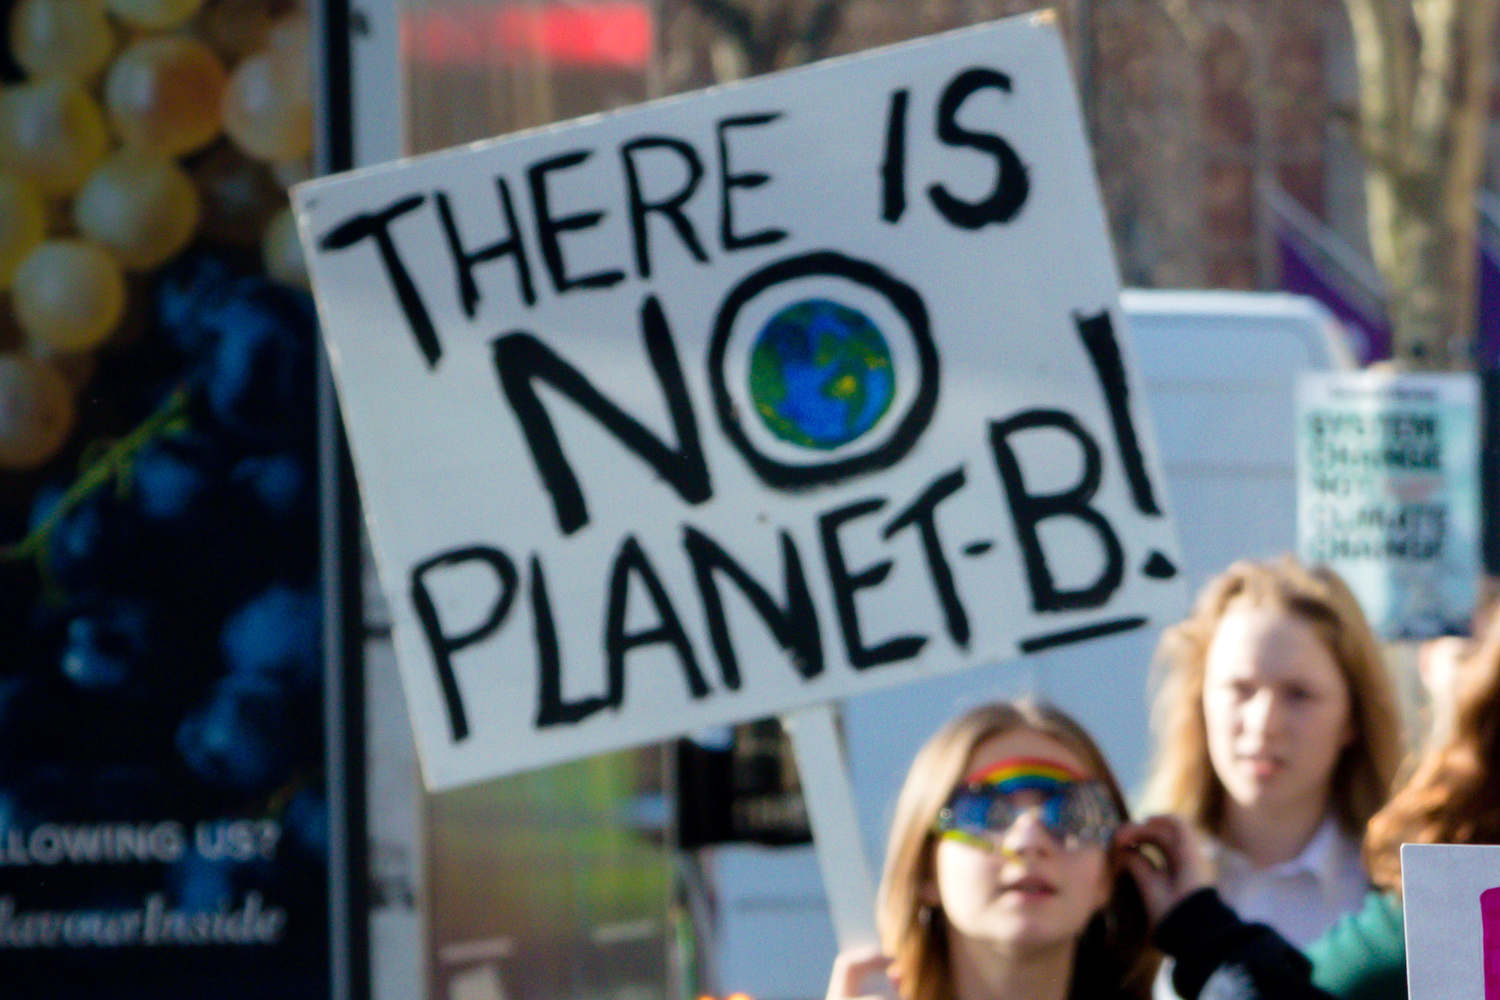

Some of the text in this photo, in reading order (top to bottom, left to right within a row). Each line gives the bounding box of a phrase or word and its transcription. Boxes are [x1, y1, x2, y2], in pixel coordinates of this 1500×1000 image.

[318, 67, 1031, 370] THERE IS
[490, 250, 940, 536] NO
[0, 819, 282, 866] LOWING US?
